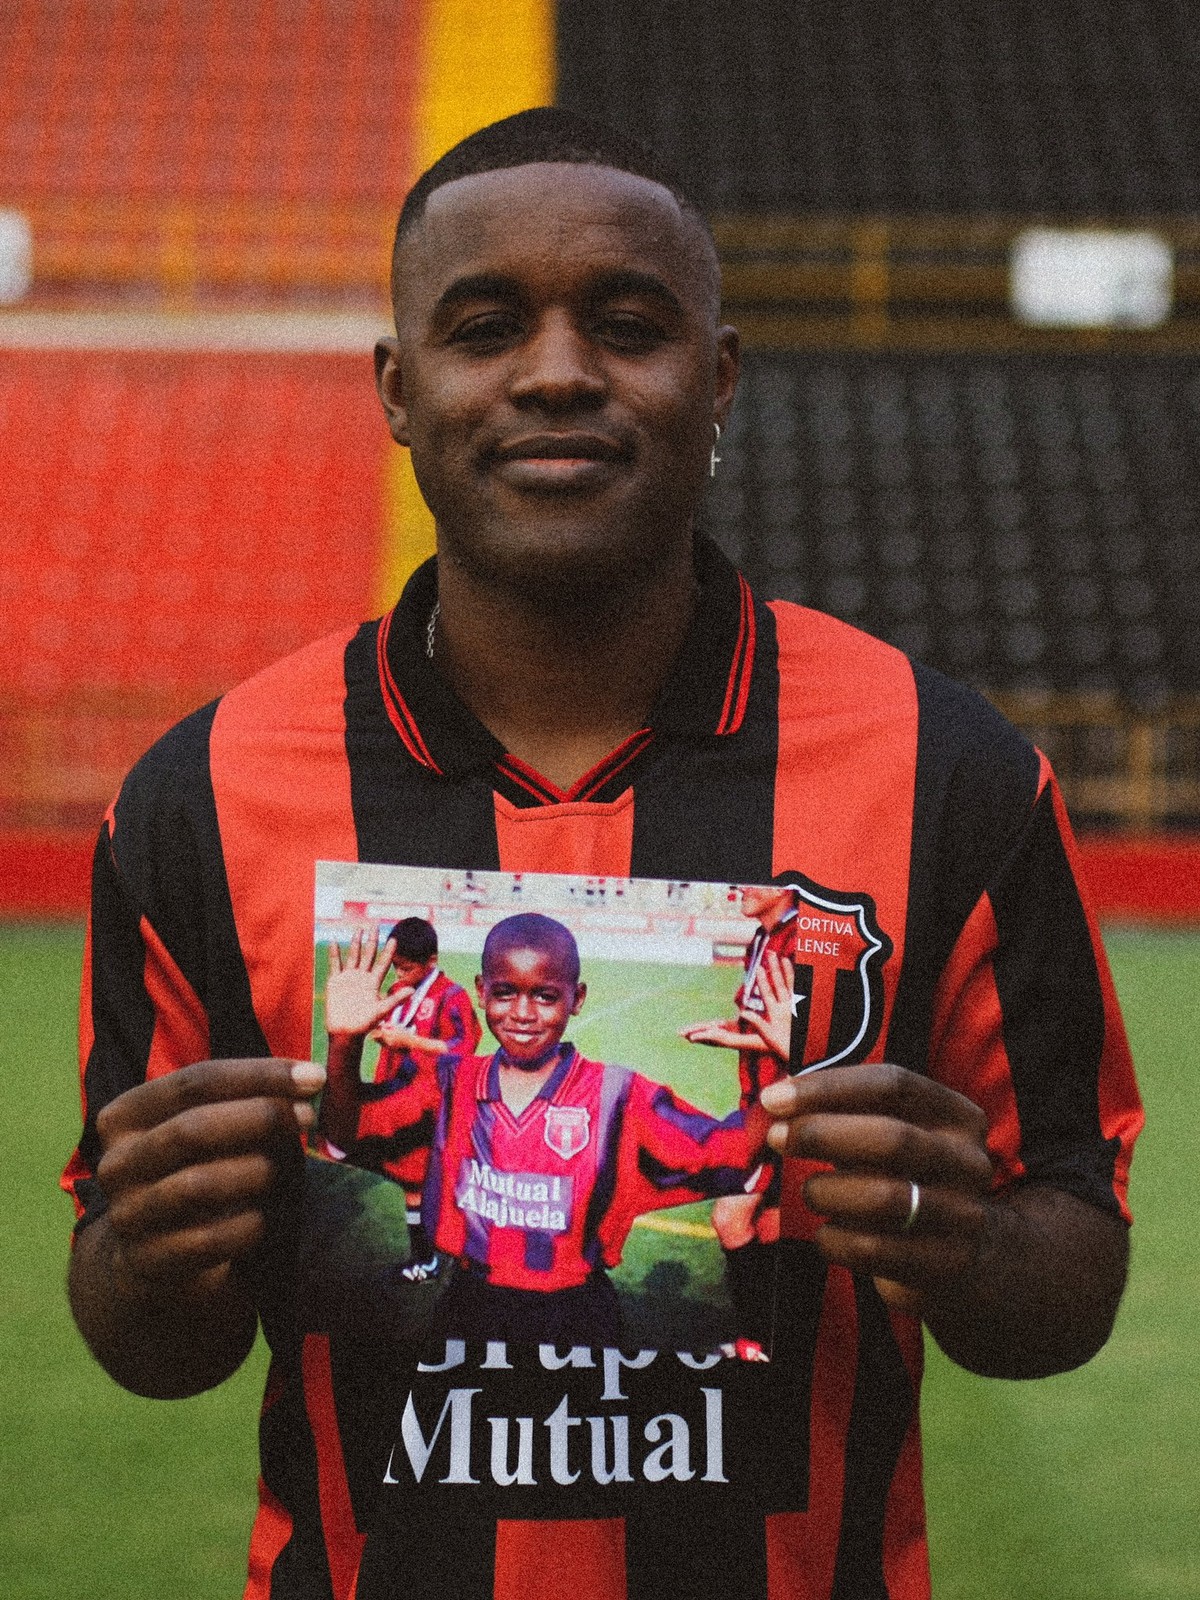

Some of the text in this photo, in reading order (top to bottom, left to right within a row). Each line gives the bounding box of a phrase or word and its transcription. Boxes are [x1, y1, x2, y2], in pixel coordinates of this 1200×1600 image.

[797, 917, 853, 936] ORTIVA
[471, 1158, 561, 1202] Mutual
[458, 1187, 567, 1230] Alajuela
[383, 1387, 729, 1486] Mutual
